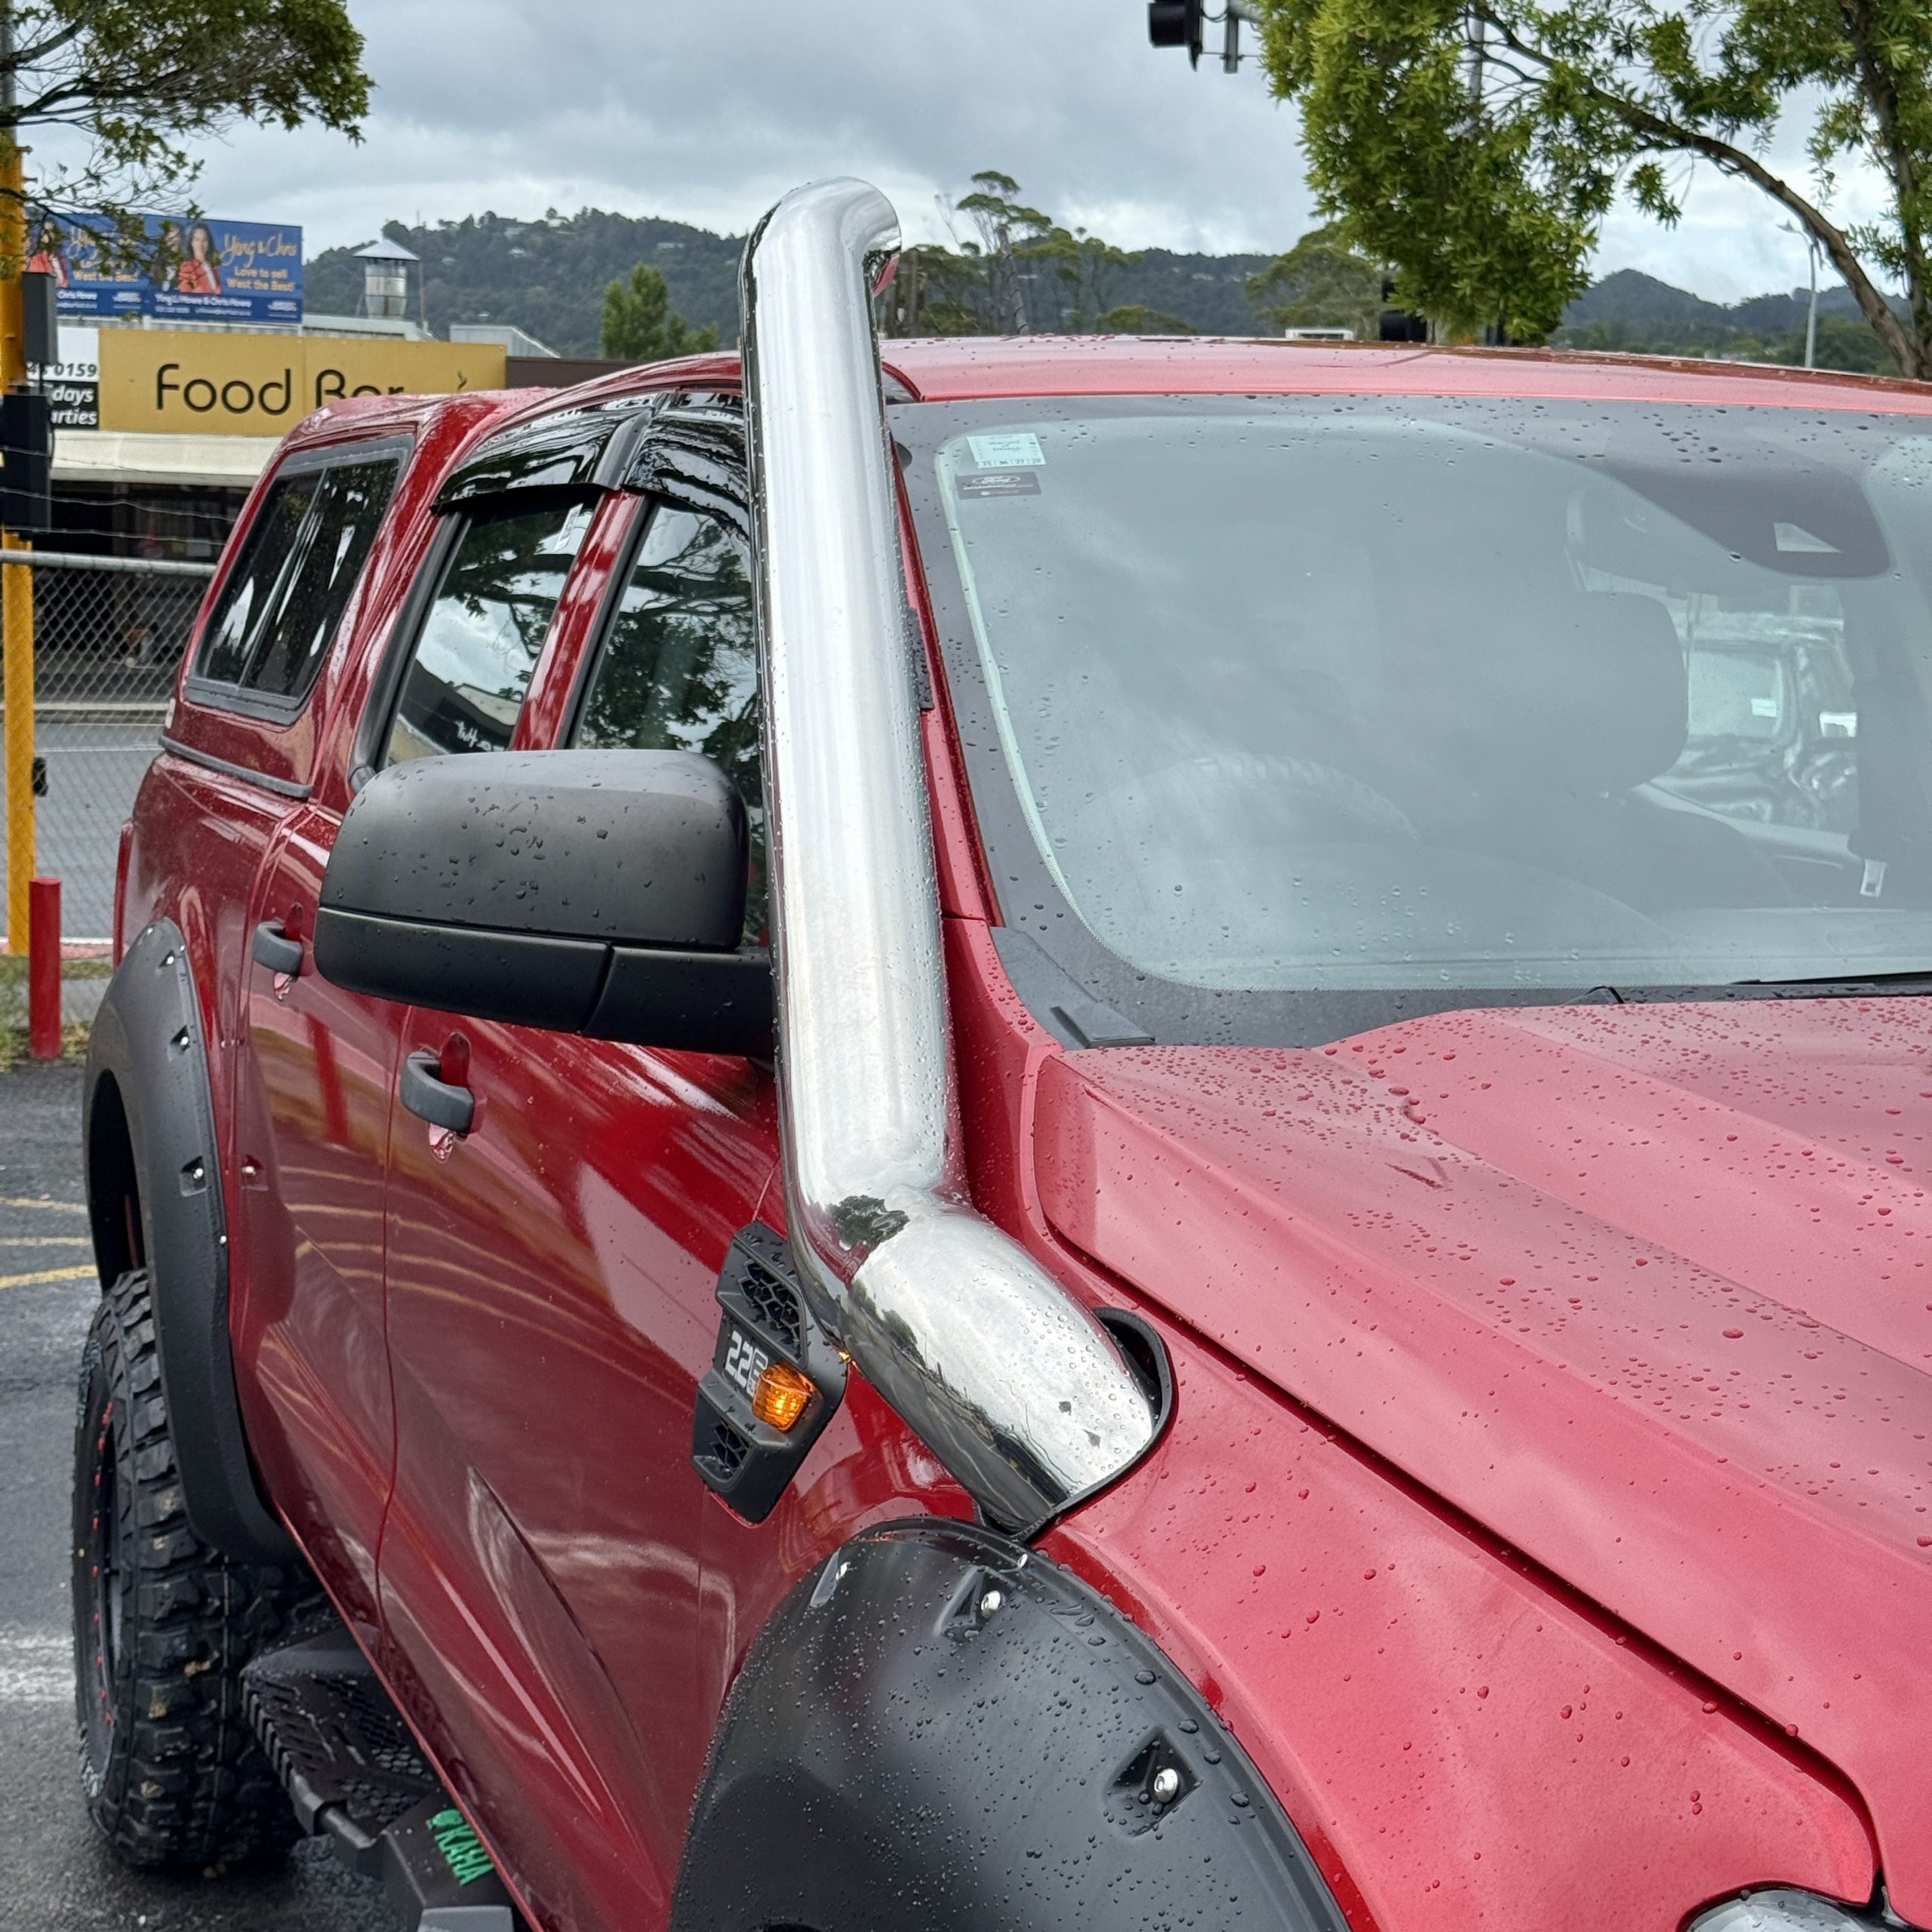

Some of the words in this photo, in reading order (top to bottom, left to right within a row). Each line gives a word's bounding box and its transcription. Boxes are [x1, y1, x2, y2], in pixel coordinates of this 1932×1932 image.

[219, 233, 255, 268] Ying
[234, 266, 257, 277] Love
[259, 269, 269, 278] to
[271, 269, 288, 278] sell
[227, 278, 251, 289] West
[253, 279, 269, 290] the
[54, 363, 97, 377] 0159
[156, 363, 291, 416] Food
